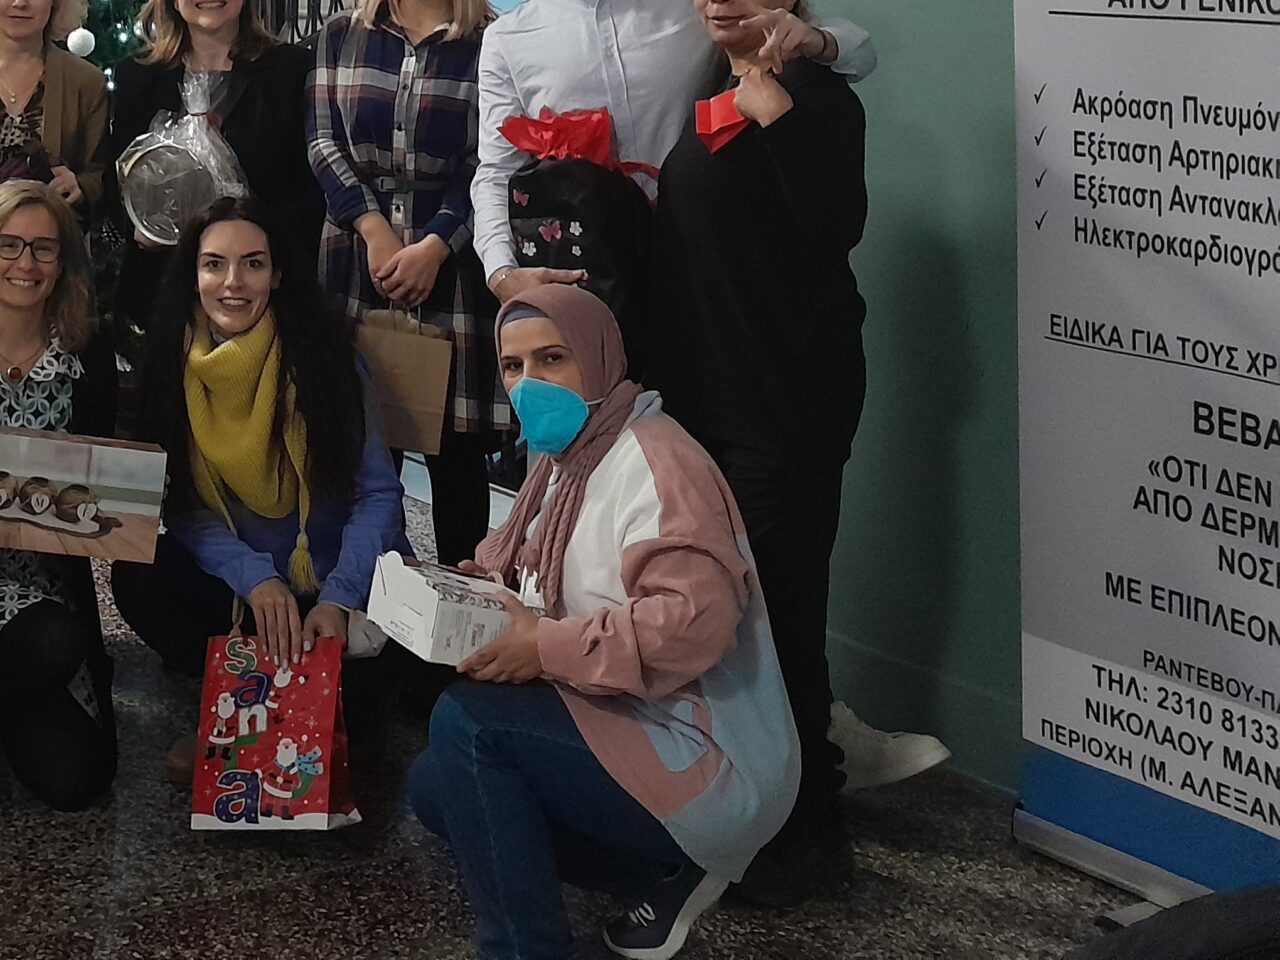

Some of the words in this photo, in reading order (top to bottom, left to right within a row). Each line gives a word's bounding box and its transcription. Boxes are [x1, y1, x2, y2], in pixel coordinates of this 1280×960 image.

[1072, 87, 1173, 129] Ακρόαση
[1073, 130, 1162, 172] Εξέταση
[1168, 140, 1280, 180] Αρτηριακ
[1074, 173, 1162, 217] Εξέταση
[1168, 184, 1280, 227] Αντανακλ
[1050, 313, 1124, 349] ΕΙΔΙΚΑ
[1132, 328, 1169, 357] ΓΙΑ
[1176, 336, 1239, 371] ΤΟΥΣ
[1194, 400, 1280, 450] ΒΕΒΑ
[1148, 455, 1207, 490] «ΟΤΙ
[1215, 468, 1271, 508] ΔΕΝ
[1133, 485, 1192, 523] ΑΠΟ
[1201, 502, 1279, 549] ΔΕΡΜ
[1105, 571, 1142, 605] ΜΕ
[1218, 544, 1280, 590] ΝΟΣ
[1091, 663, 1148, 704] ΤΗΛ:
[1157, 686, 1213, 725] 2310
[1221, 708, 1279, 750] 8133
[1041, 718, 1133, 770] ΠΕΡΙΟΧΗ
[1085, 697, 1214, 761] ΝΙΚΟΛΑΟΥ
[1223, 745, 1280, 790] ΜΑΝ
